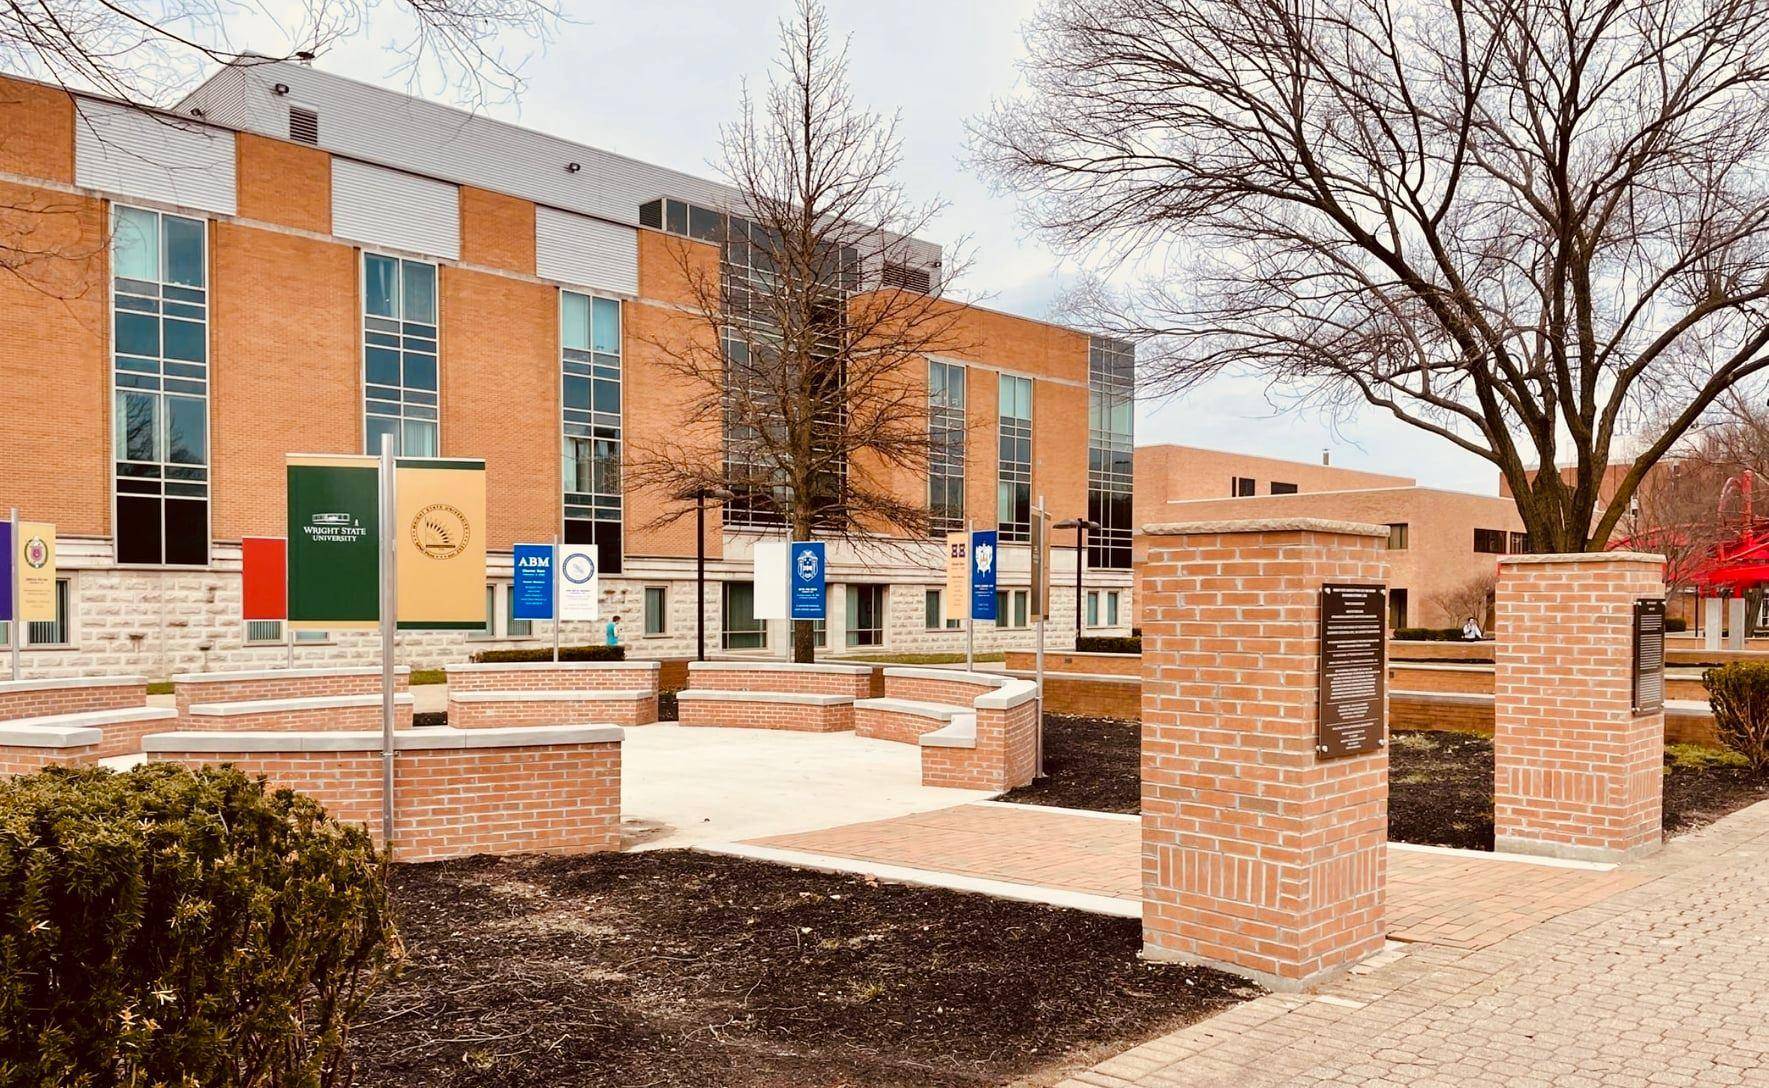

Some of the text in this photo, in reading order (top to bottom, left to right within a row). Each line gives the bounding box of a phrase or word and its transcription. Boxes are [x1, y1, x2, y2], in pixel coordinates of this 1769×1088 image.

[303, 526, 367, 536] WRIGHT STATE
[312, 535, 357, 543] UNIVERSITY
[518, 556, 550, 567] ABM
